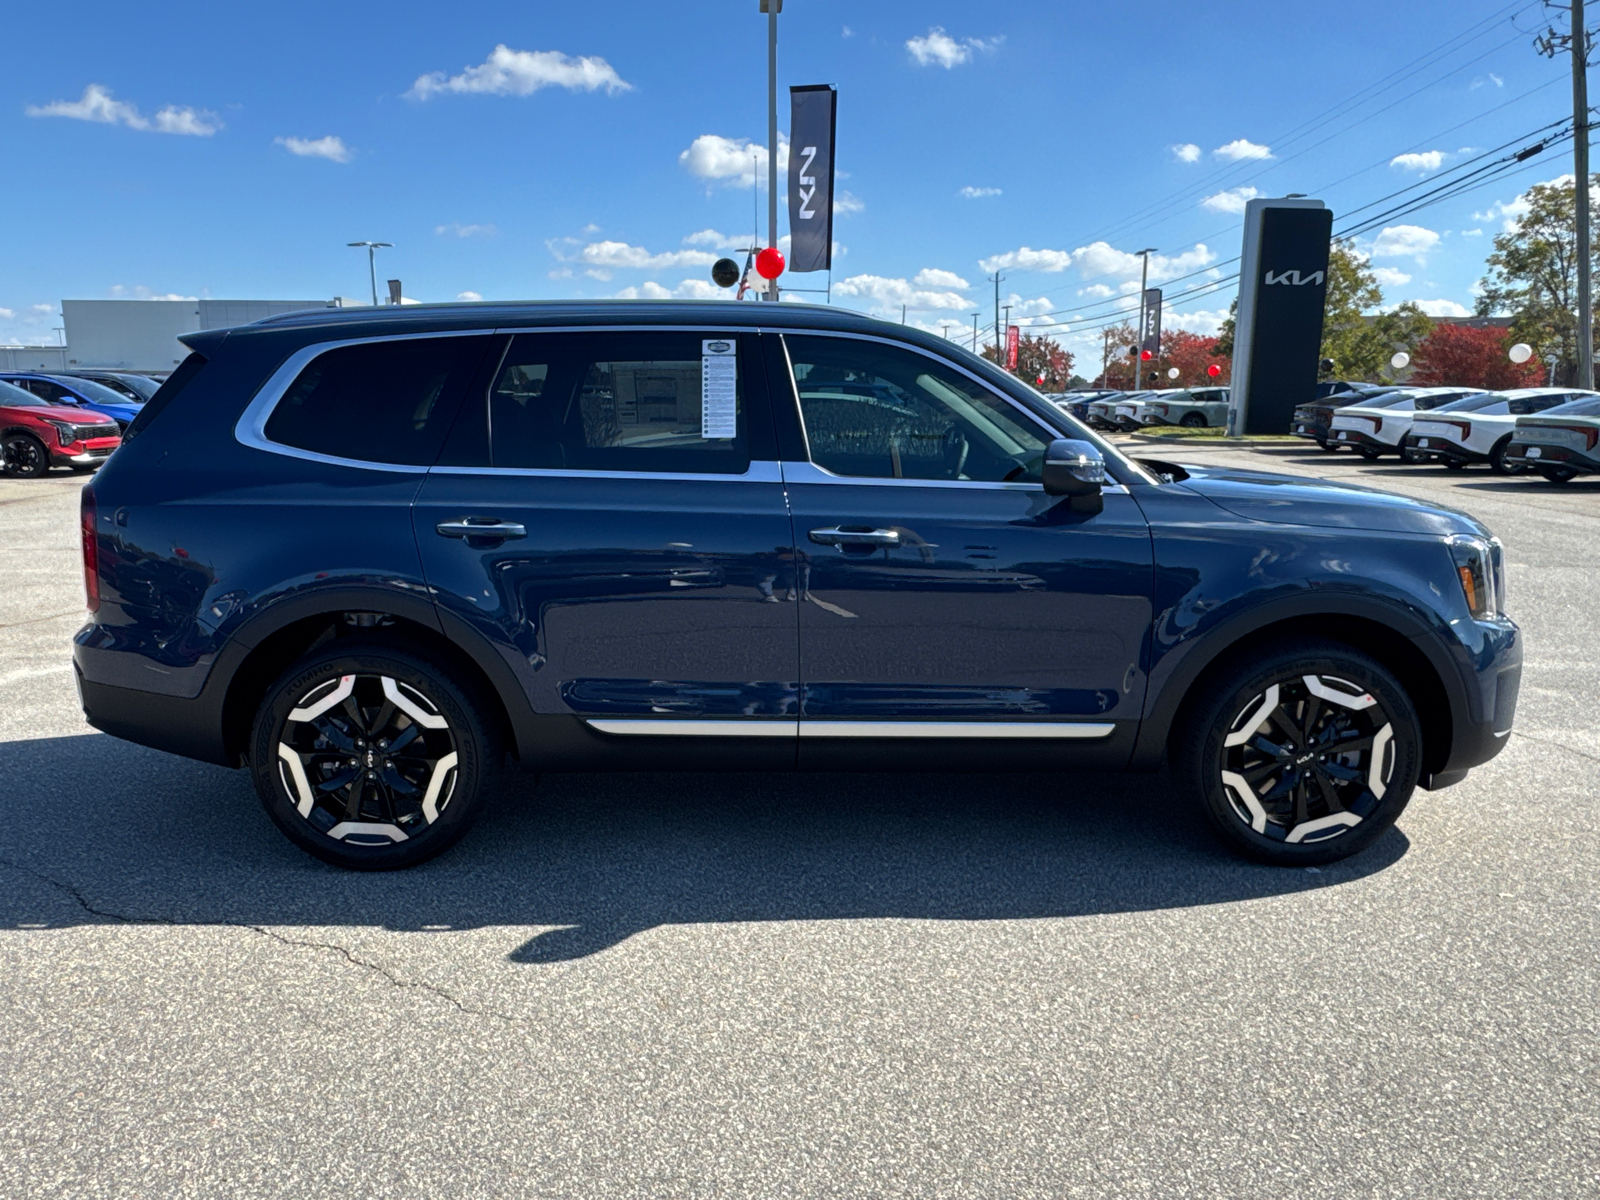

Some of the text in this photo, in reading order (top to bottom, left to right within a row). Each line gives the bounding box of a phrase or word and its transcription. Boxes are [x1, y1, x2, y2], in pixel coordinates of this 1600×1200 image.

[1265, 269, 1324, 286] KIA
[285, 663, 334, 696] KUMHO
[1296, 752, 1315, 764] KIA
